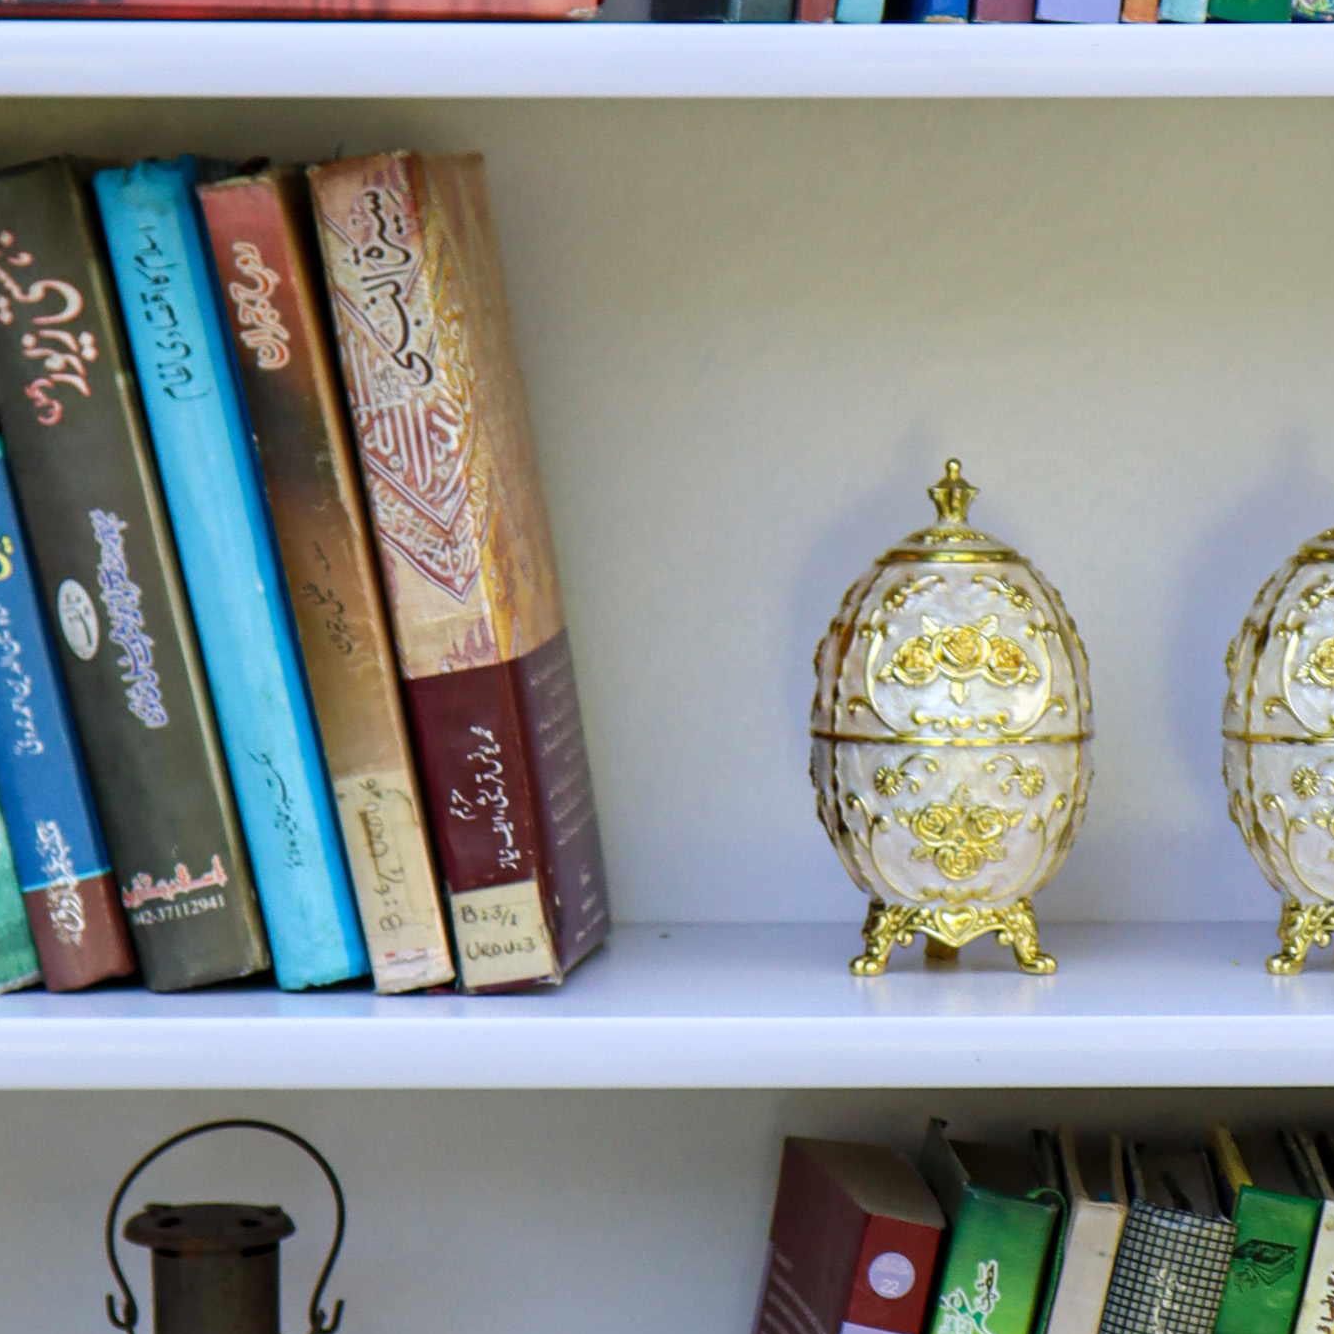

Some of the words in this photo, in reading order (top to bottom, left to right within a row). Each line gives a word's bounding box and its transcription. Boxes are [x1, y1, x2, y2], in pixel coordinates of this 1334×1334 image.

[133, 226, 173, 276] اسلام
[135, 263, 169, 286] کا
[139, 288, 191, 365] اقتصادی
[22, 328, 97, 407] زیور
[156, 353, 194, 400] نظام
[469, 725, 494, 743] محمد
[466, 740, 504, 776] یونس
[449, 788, 476, 820] مترجم
[492, 815, 514, 848] ایف
[498, 845, 521, 870] نیاز
[879, 1279, 899, 1295] 22
